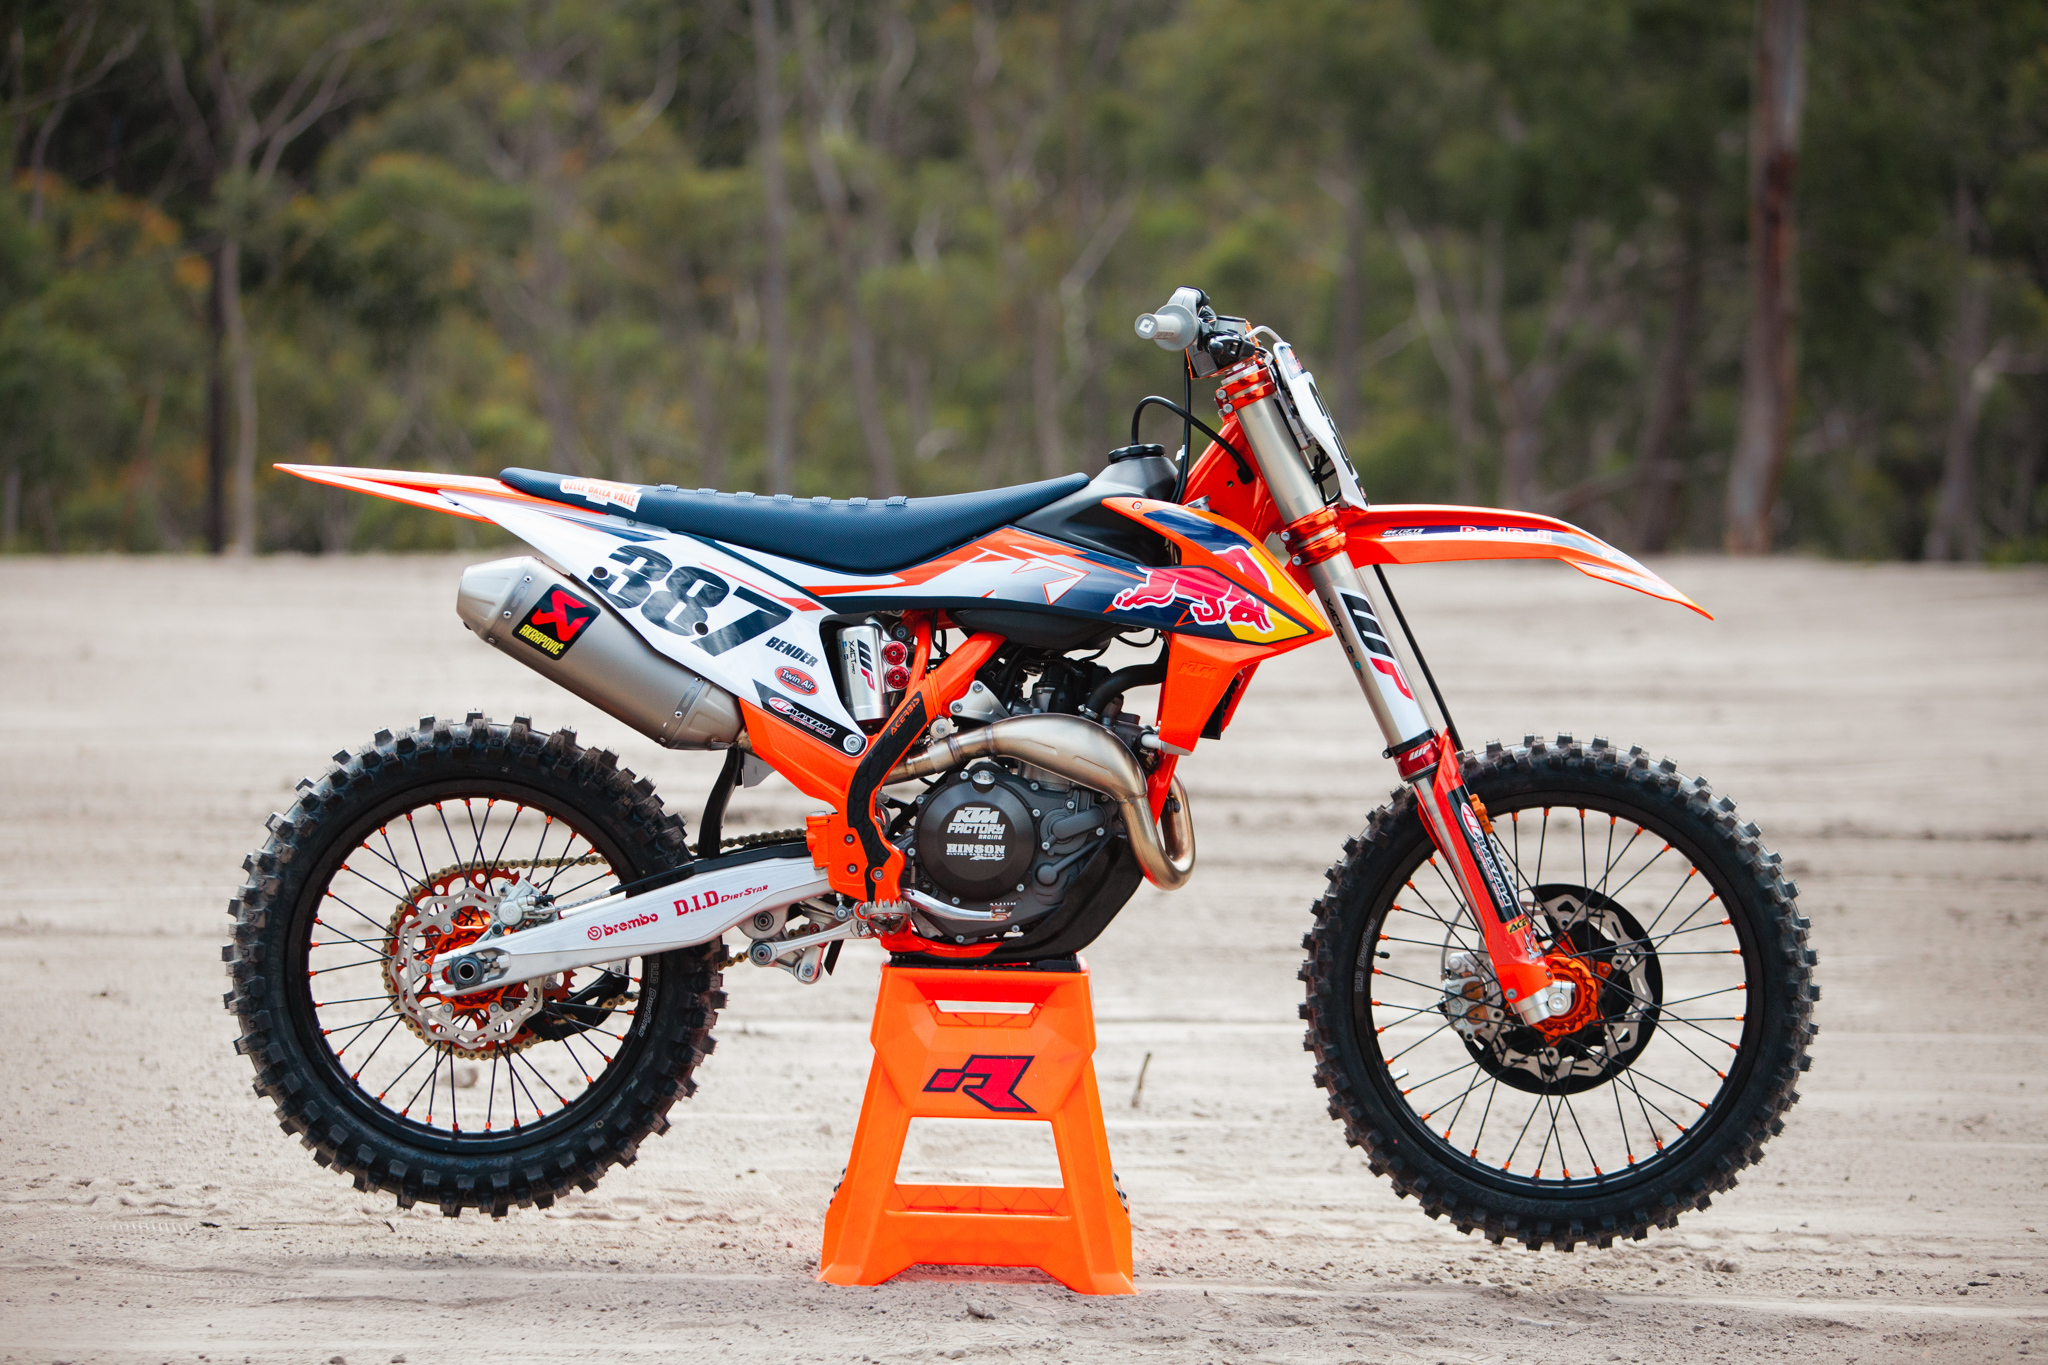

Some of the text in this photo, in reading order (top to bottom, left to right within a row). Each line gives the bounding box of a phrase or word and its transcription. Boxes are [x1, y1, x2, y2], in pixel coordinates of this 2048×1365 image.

[588, 486, 611, 499] DALLA
[614, 492, 636, 507] VALLE
[587, 545, 793, 657] 387
[1324, 598, 1344, 630] XACT
[765, 636, 819, 667] BENDER
[848, 640, 857, 664] XACT
[781, 668, 801, 684] Twin
[800, 679, 816, 690] Air
[1177, 661, 1218, 680] KTM
[890, 698, 920, 736] ACERBIS
[953, 806, 1000, 824] KTM
[946, 822, 1006, 835] FACTORY
[946, 843, 1006, 854] HINSON
[673, 890, 720, 917] D.I.D
[602, 913, 659, 937] brembo
